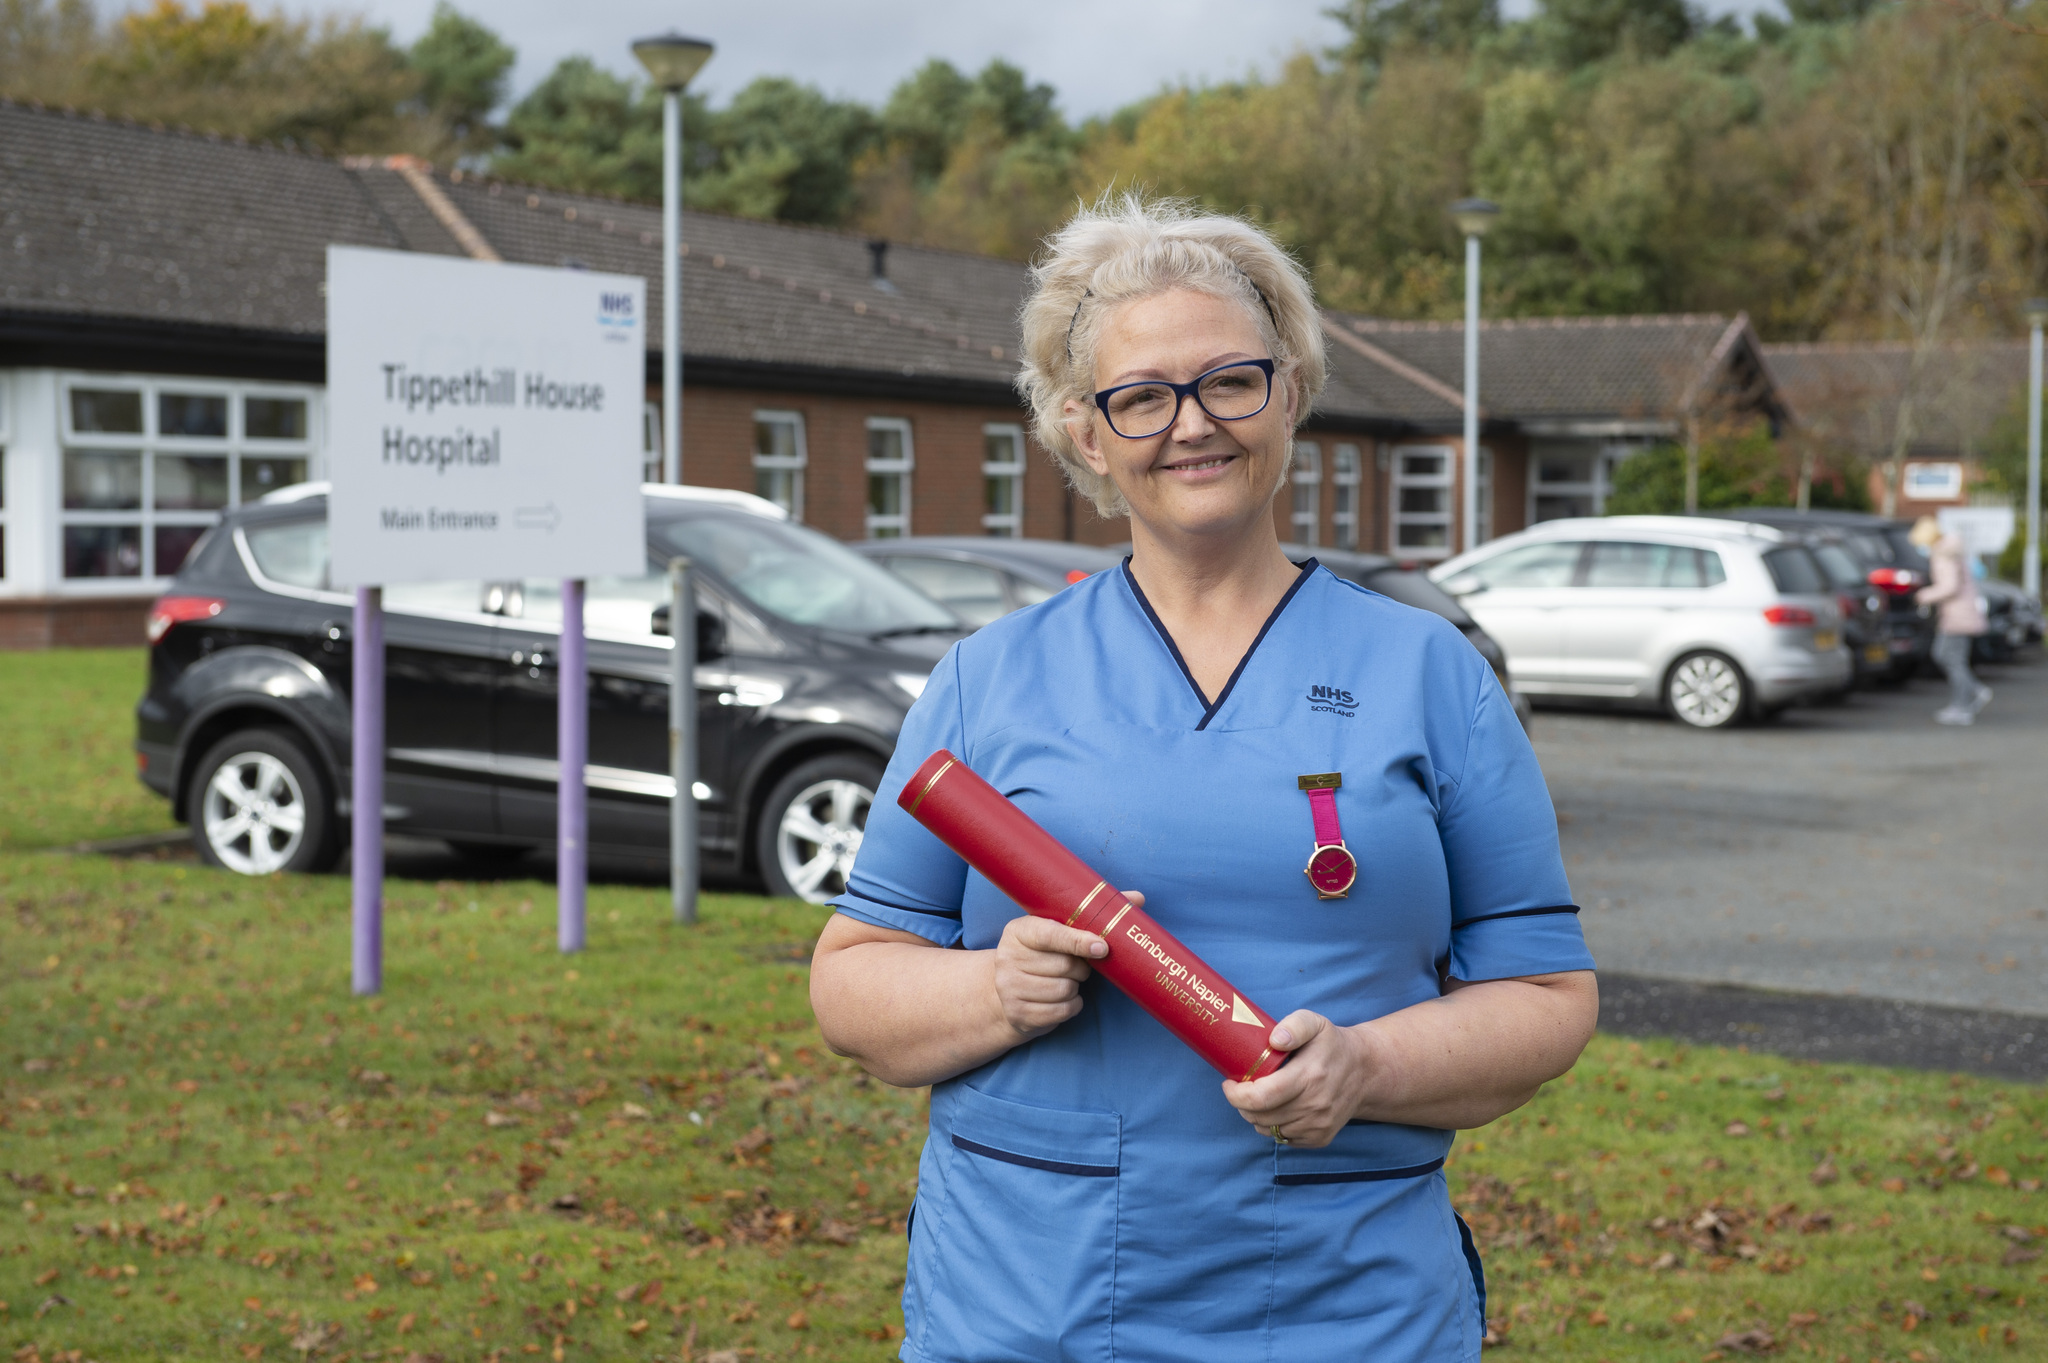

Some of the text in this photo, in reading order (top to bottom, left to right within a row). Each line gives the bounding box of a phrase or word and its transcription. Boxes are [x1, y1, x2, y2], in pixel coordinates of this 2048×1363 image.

[601, 292, 634, 315] NHS
[380, 362, 605, 413] Tippethill House
[382, 425, 500, 474] Hospital
[381, 506, 498, 531] Main Entrance
[1310, 705, 1355, 718] SCOTLAND
[1311, 684, 1354, 703] NHS
[1126, 924, 1230, 1013] Edinburgh Napier
[1155, 970, 1219, 1026] UNIVERSITY
